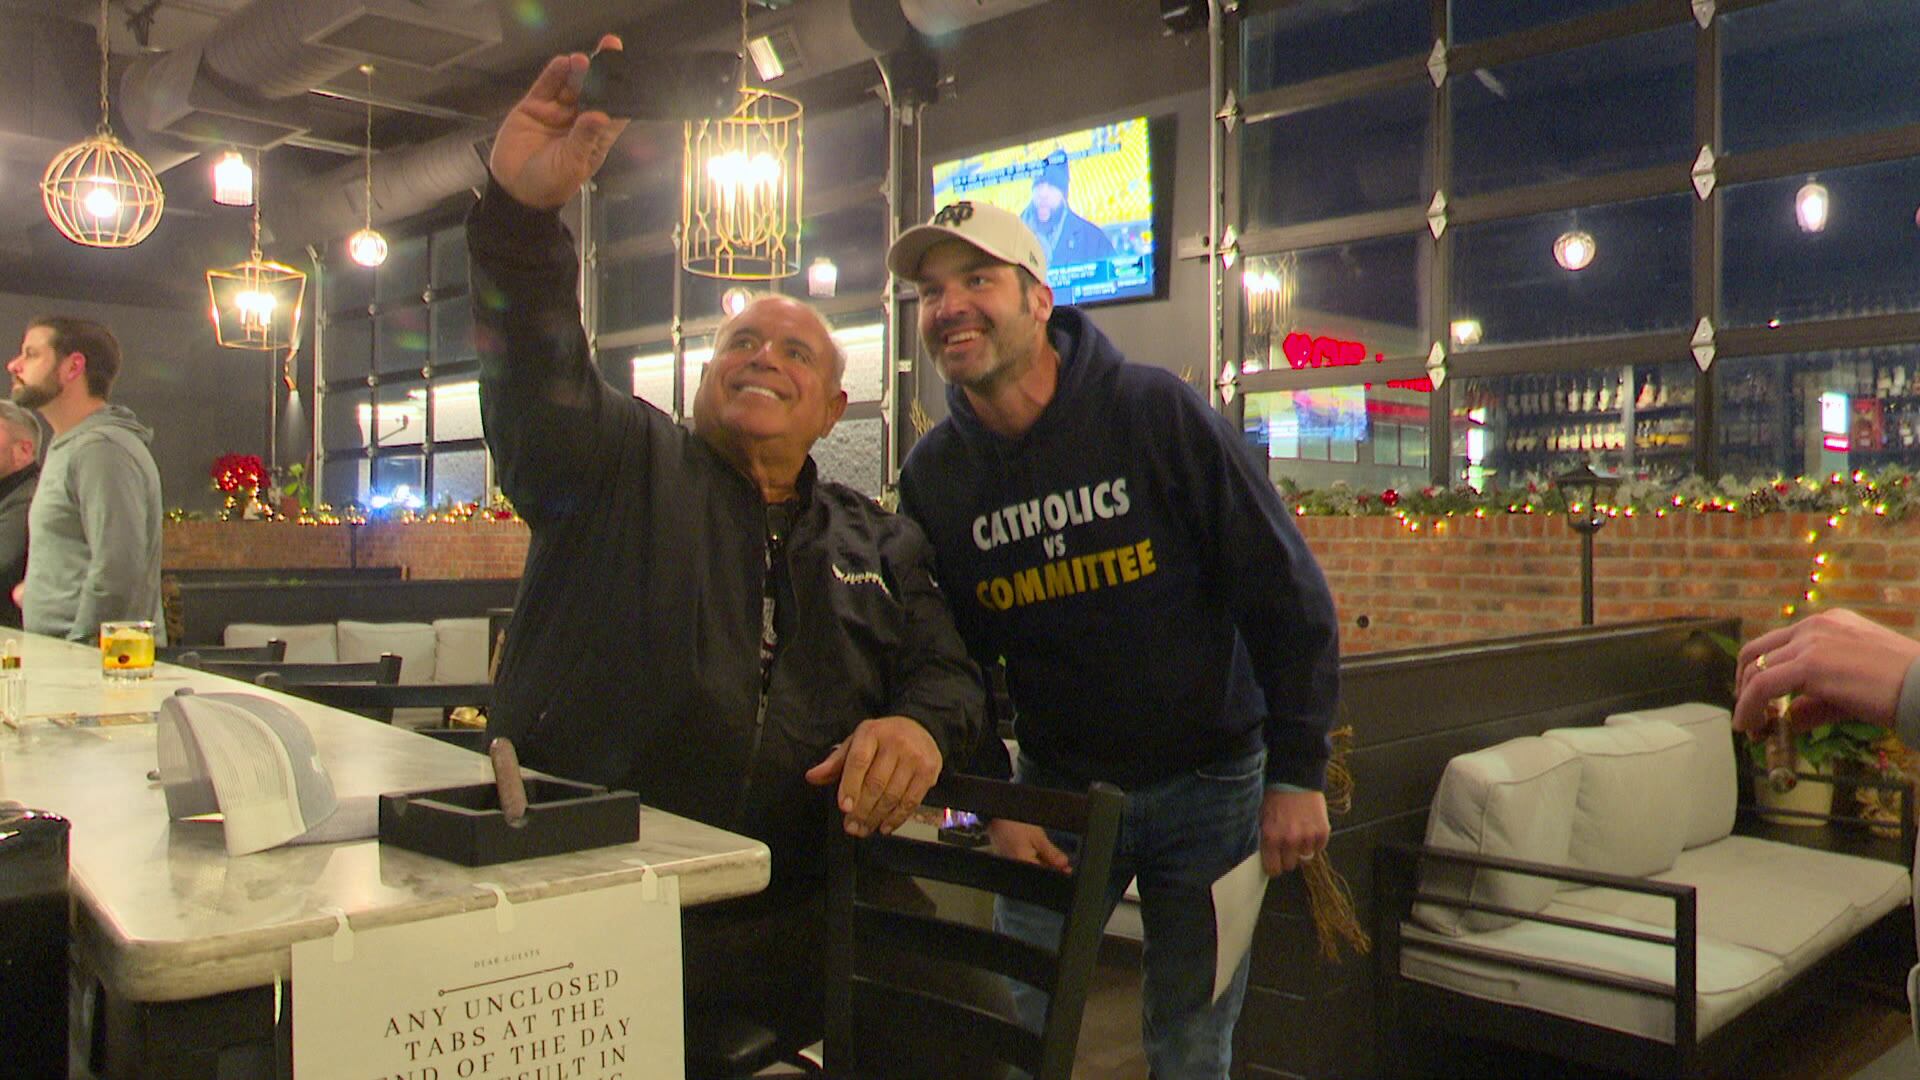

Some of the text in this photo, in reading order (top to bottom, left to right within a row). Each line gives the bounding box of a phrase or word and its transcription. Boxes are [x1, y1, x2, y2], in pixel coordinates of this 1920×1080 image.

[972, 477, 1130, 551] CATHOLICS
[976, 538, 1157, 610] COMMITTEE
[384, 969, 619, 1038] ANY UNCLOSED
[405, 998, 605, 1061] TABS AT THE
[457, 1052, 496, 1078] OF
[510, 1034, 566, 1065] THE
[581, 1017, 631, 1048] DAY
[600, 1045, 626, 1068] IN
